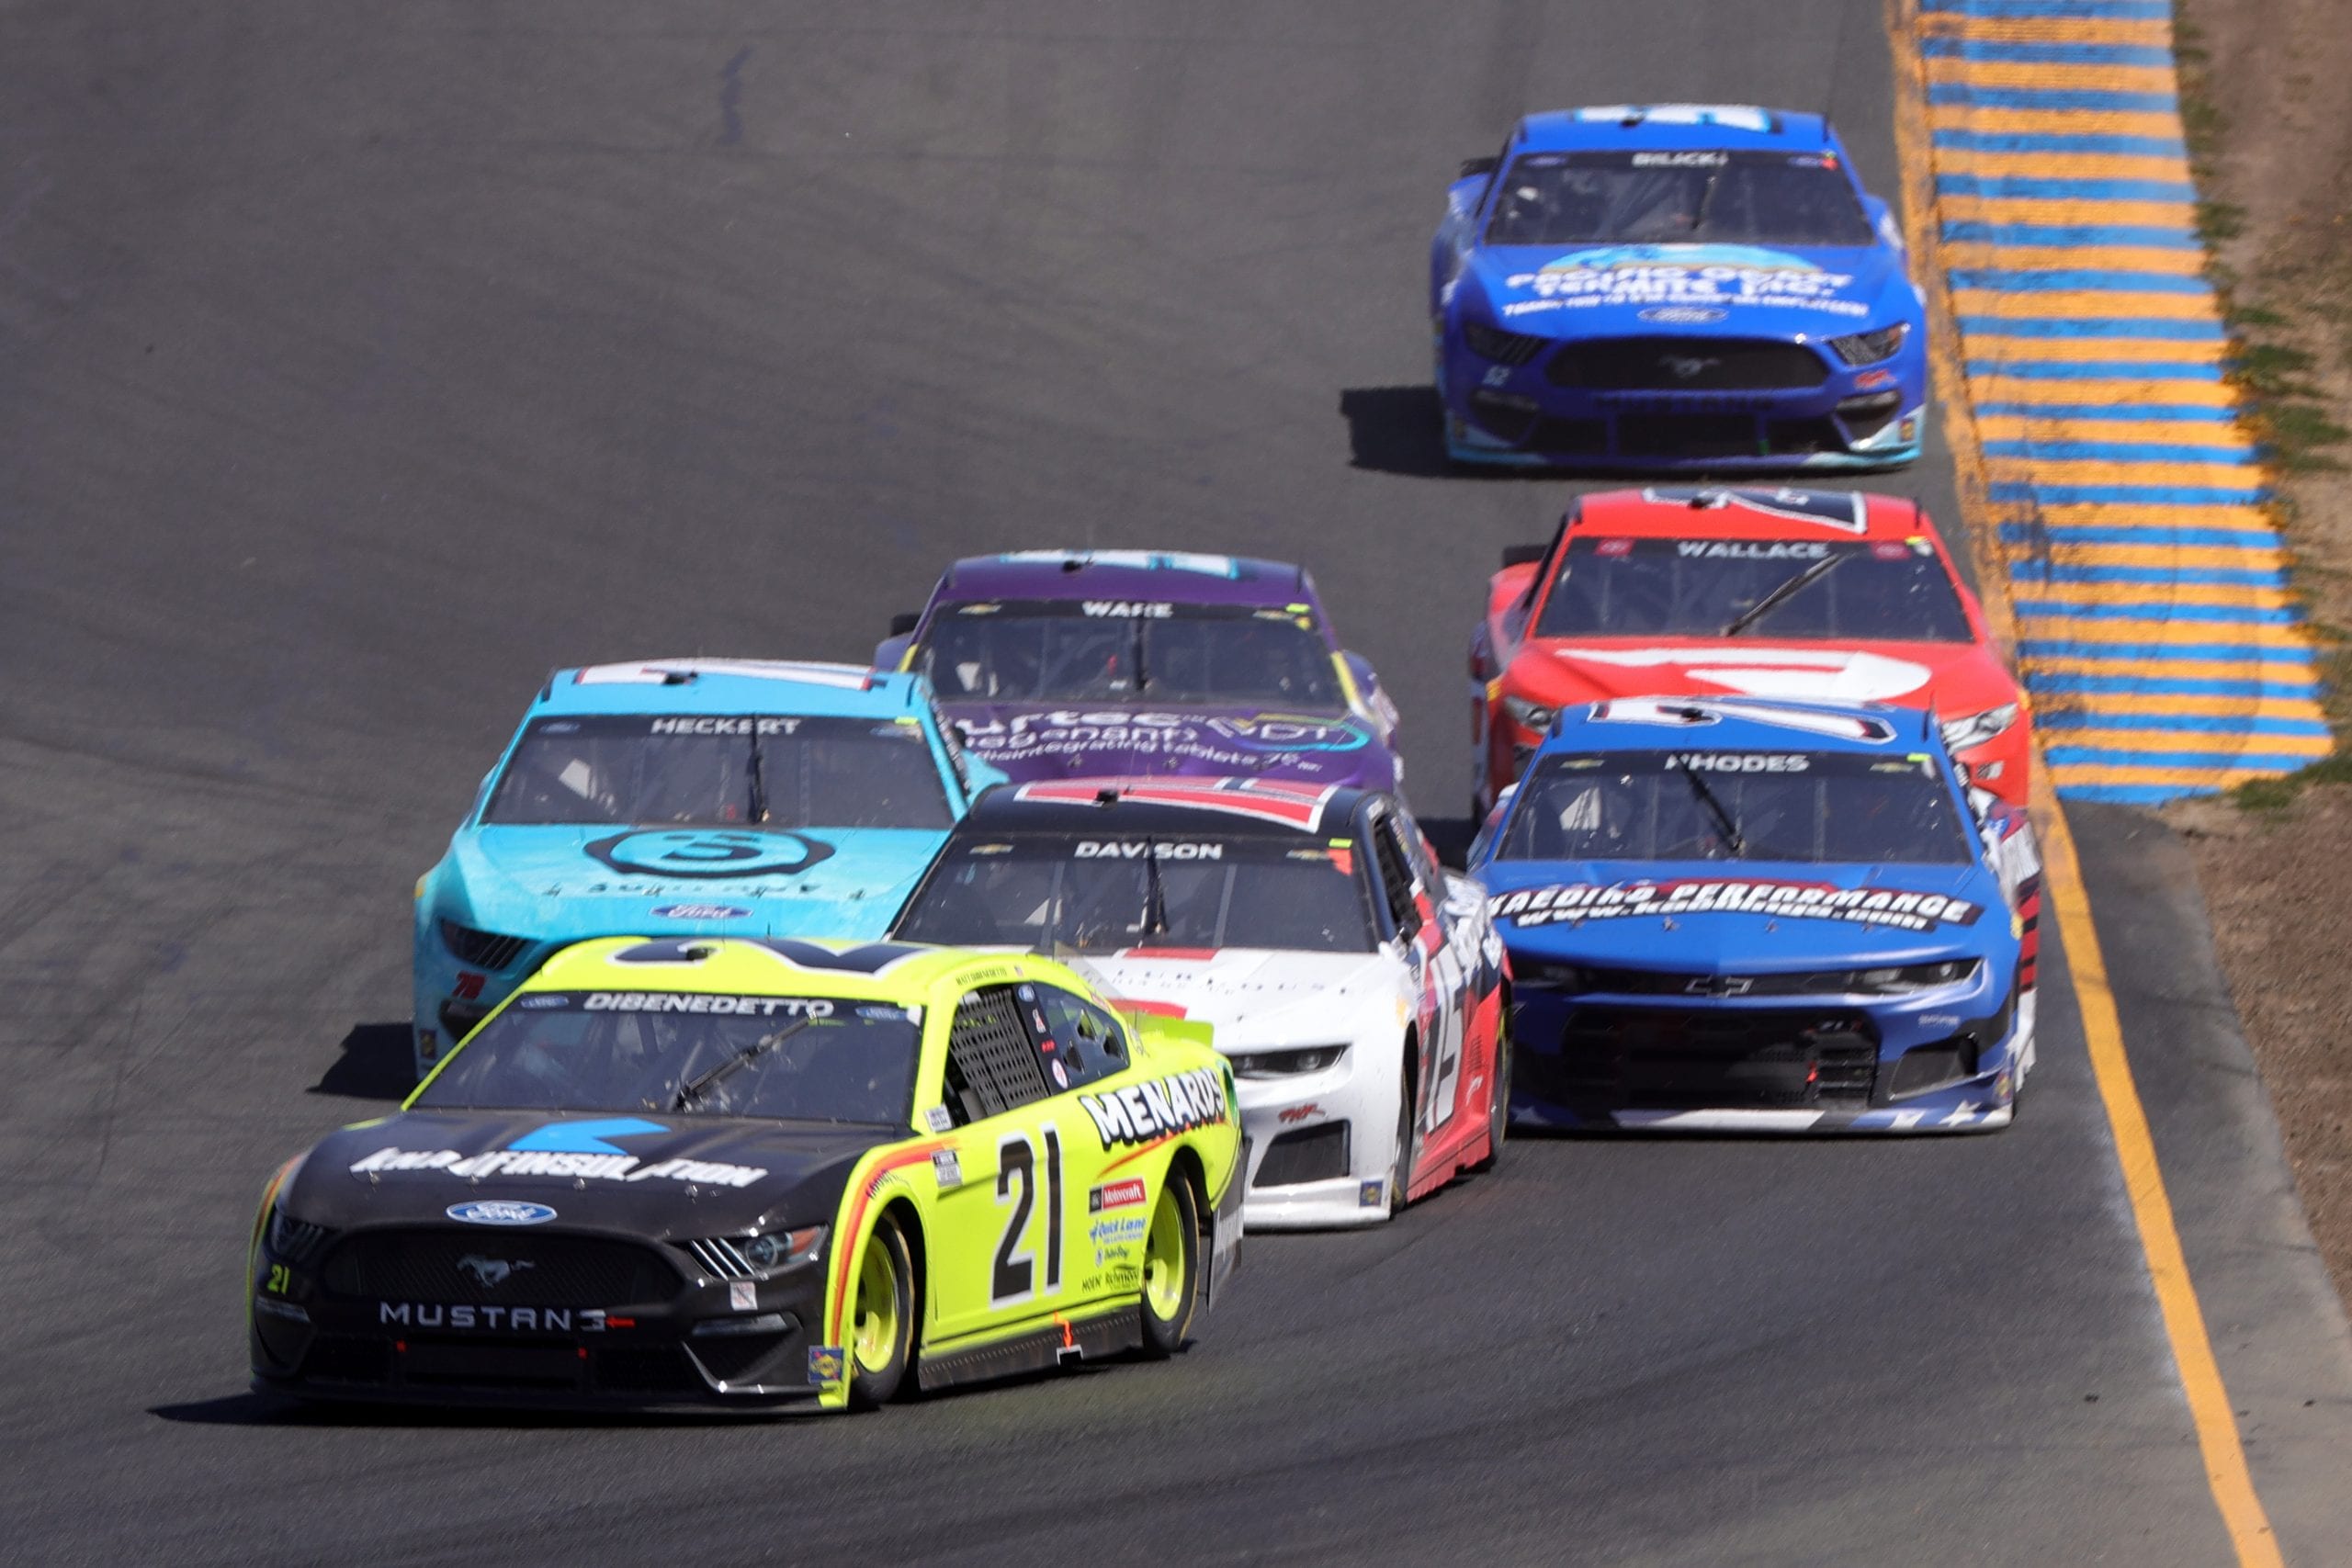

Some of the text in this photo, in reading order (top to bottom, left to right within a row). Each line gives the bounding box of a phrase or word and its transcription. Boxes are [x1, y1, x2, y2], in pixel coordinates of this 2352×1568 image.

[1678, 541, 1830, 558] WALLACE
[1082, 602, 1174, 618] WARE
[650, 717, 802, 735] HECKERT
[955, 710, 1181, 736] urtec
[1664, 753, 1810, 773] RHODES
[583, 992, 834, 1017] DIBENEDETTO
[1080, 1067, 1227, 1151] MENARDS
[1103, 1183, 1143, 1204] Motorcraft
[990, 1121, 1064, 1310] 21
[267, 1263, 290, 1294] 21
